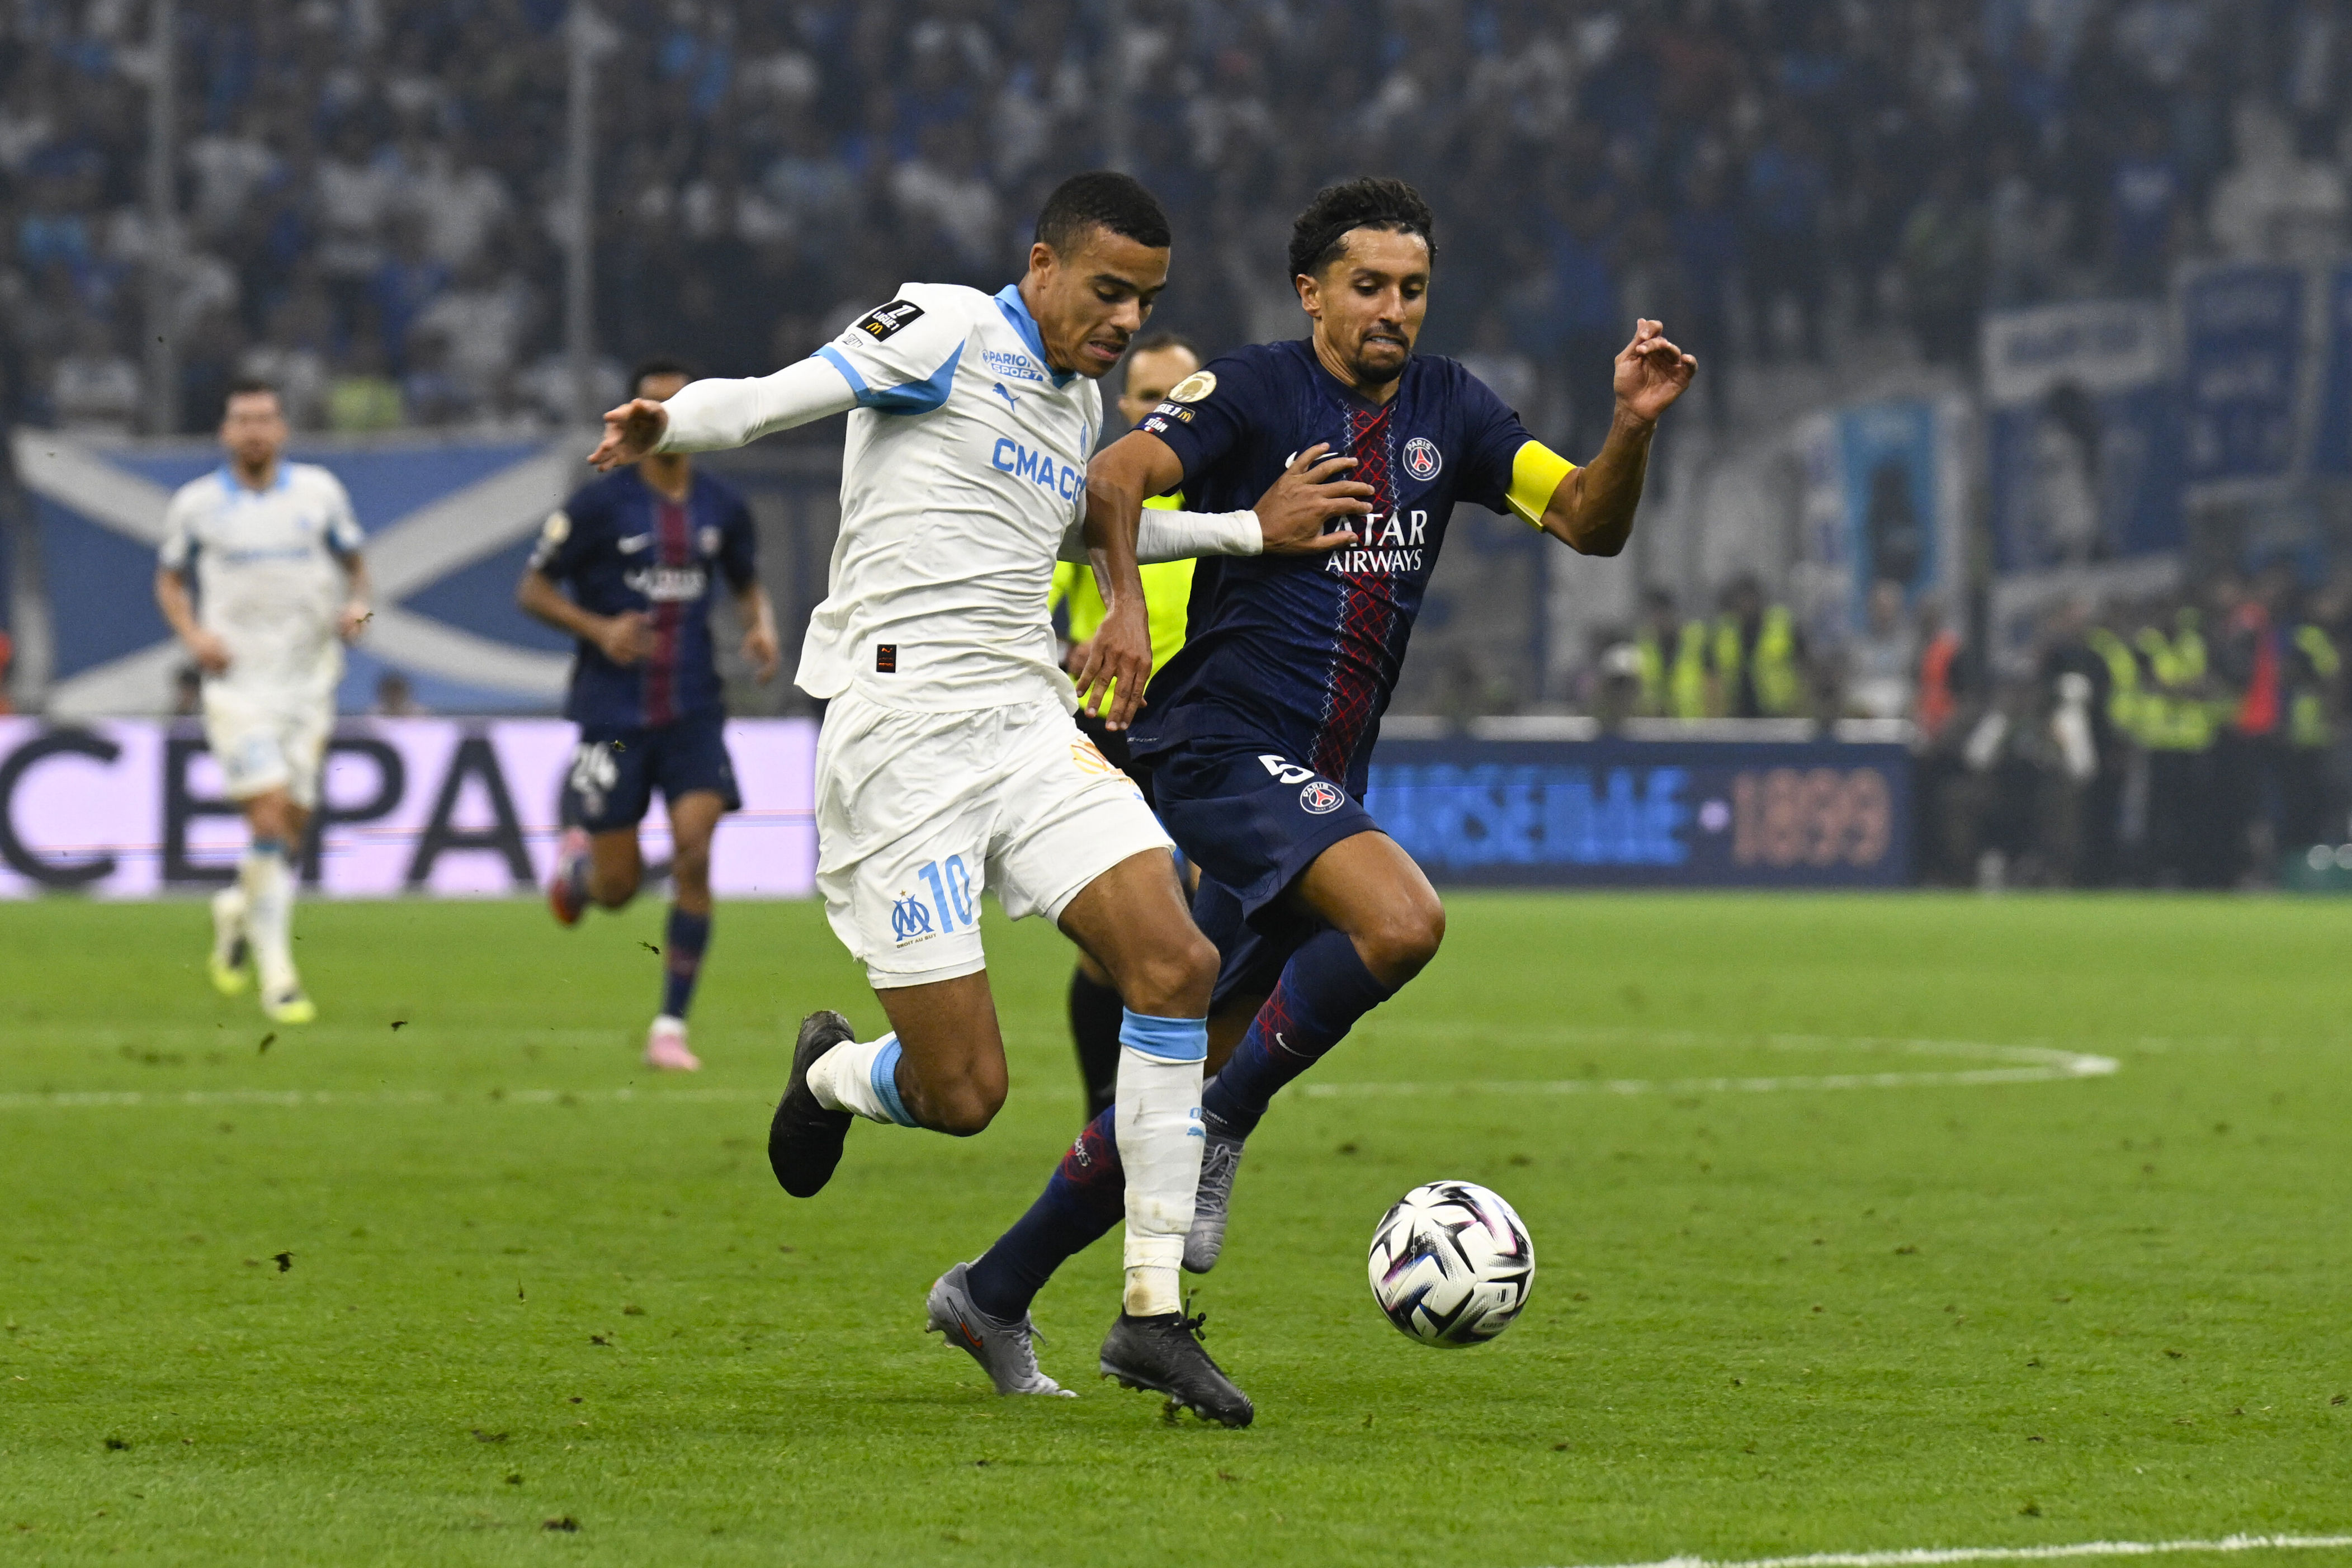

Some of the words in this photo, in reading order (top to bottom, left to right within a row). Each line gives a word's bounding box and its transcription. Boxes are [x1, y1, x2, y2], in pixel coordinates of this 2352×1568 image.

[989, 351, 1031, 367] PARIO
[1407, 440, 1432, 451] PARIS
[992, 437, 1056, 492] CMA
[1319, 510, 1428, 547] ATAR
[1325, 549, 1423, 573] AIRWAYS
[1258, 755, 1315, 784] 5
[1303, 783, 1329, 797] PARIS
[0, 729, 677, 886] CEPA
[918, 854, 973, 934] 10
[896, 940, 913, 949] DROIT
